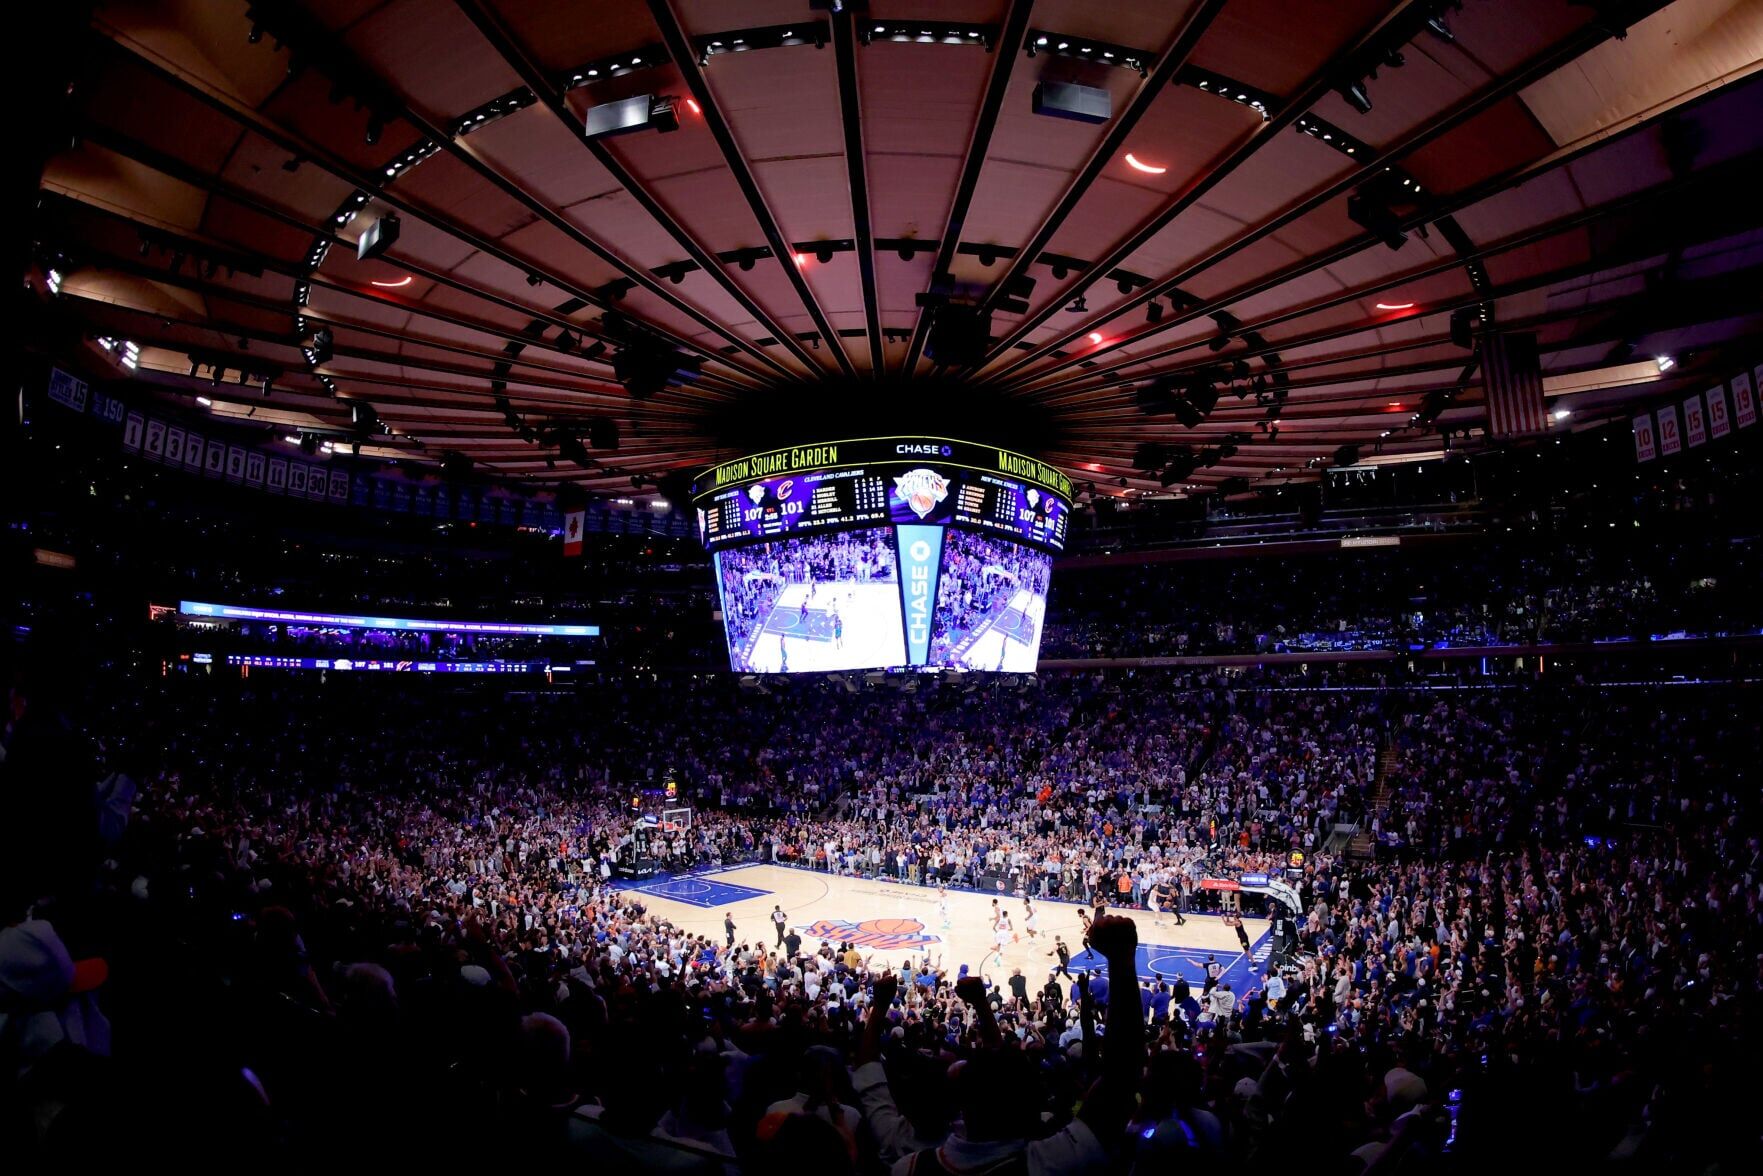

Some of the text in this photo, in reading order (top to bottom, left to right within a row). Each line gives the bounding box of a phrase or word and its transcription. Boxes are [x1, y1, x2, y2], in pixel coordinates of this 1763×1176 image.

[75, 382, 87, 404] 15
[1737, 388, 1750, 411] 19
[103, 398, 124, 422] 150
[1711, 400, 1724, 422] 15
[1662, 420, 1676, 440] 12
[1688, 411, 1700, 431] 15
[1713, 422, 1729, 436] KNICKS
[150, 432, 159, 451] 2
[1637, 428, 1651, 447] 10
[1663, 440, 1680, 453] KNICKS
[1689, 432, 1705, 445] KNICKS
[171, 439, 179, 457] 3
[191, 445, 199, 463] 7
[896, 444, 939, 455] CHASE
[211, 451, 220, 469] 9
[232, 457, 240, 474] 9
[716, 446, 837, 485] MADISON SQUARE GARDEN
[250, 462, 261, 480] 11
[271, 467, 283, 485] 11
[804, 469, 864, 483] CLEVELAND CAVALIERS
[999, 450, 1036, 479] MADISON
[1037, 463, 1059, 489] SQUARE
[291, 471, 305, 490] 19
[310, 475, 324, 493] 30
[331, 480, 347, 497] 35
[744, 507, 764, 522] 107
[781, 501, 804, 515] 101
[1019, 508, 1036, 523] 107
[1045, 516, 1055, 531] 101
[910, 565, 929, 645] CHASE
